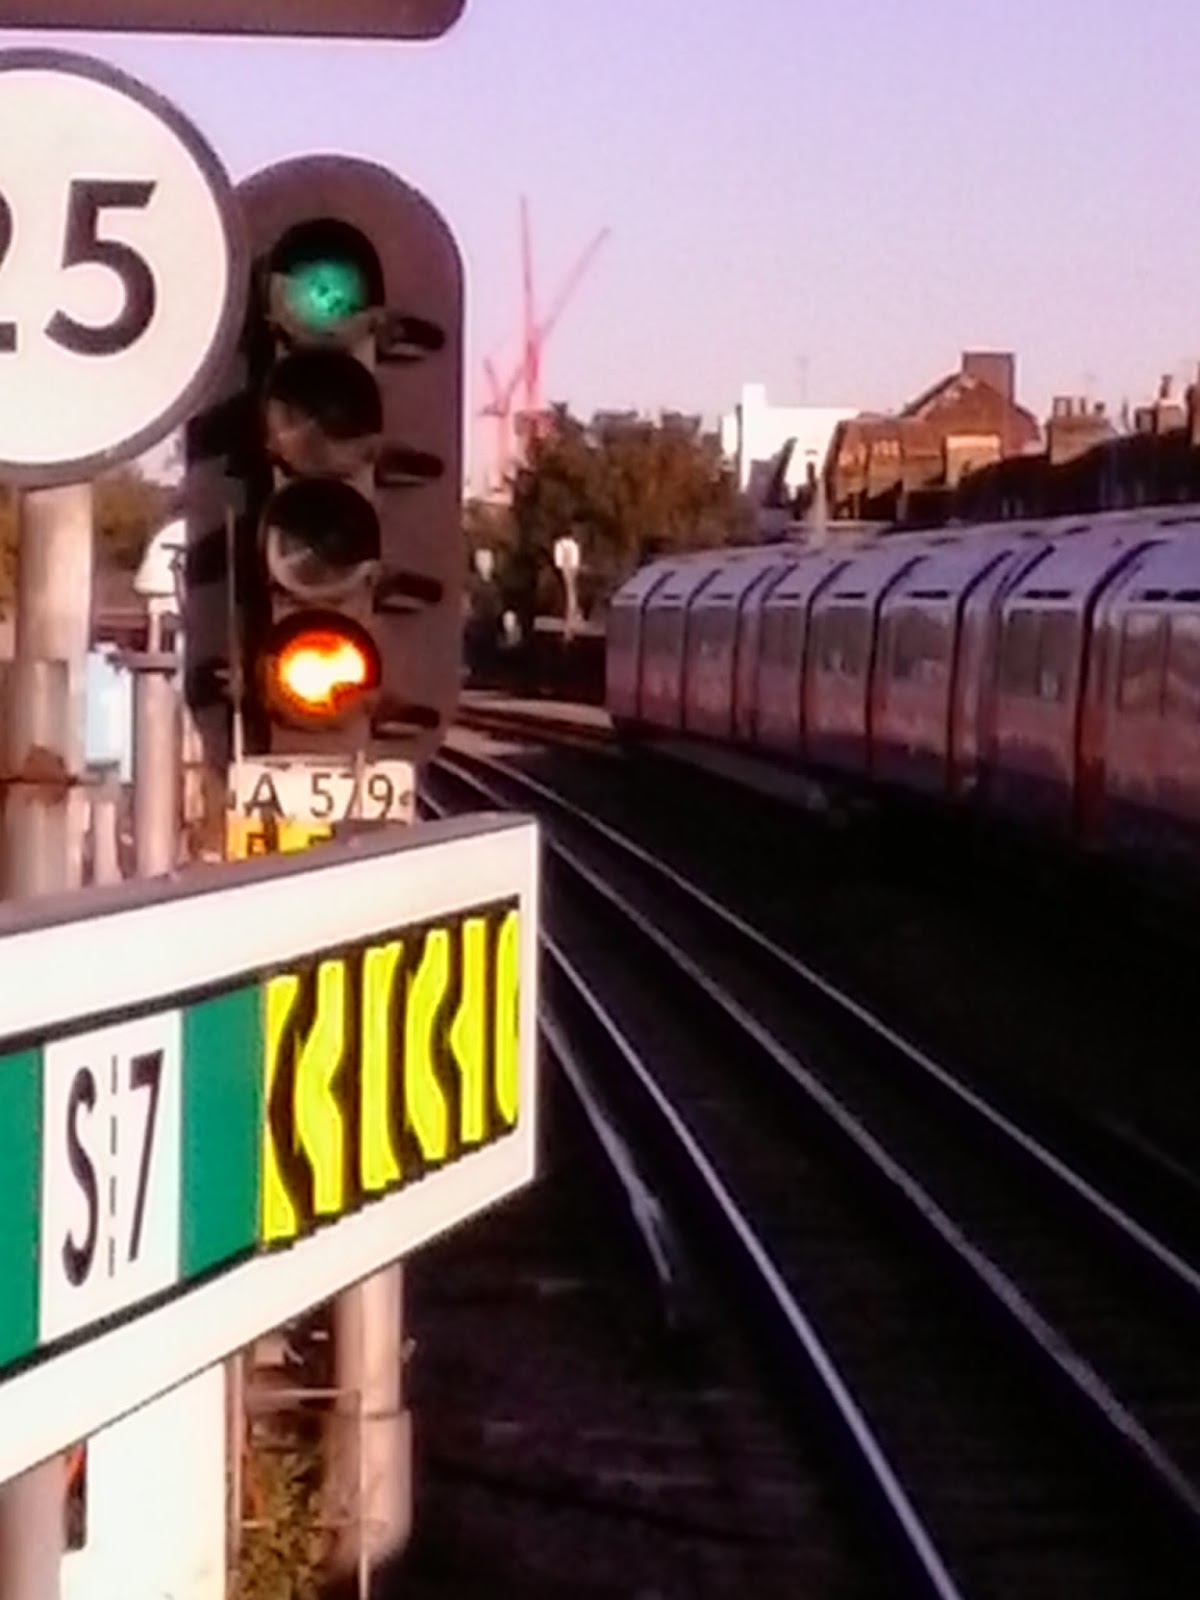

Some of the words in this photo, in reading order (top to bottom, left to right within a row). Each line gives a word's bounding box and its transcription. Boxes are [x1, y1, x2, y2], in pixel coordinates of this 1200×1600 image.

[0, 179, 157, 356] 5
[244, 772, 284, 818] A
[310, 772, 394, 820] 579
